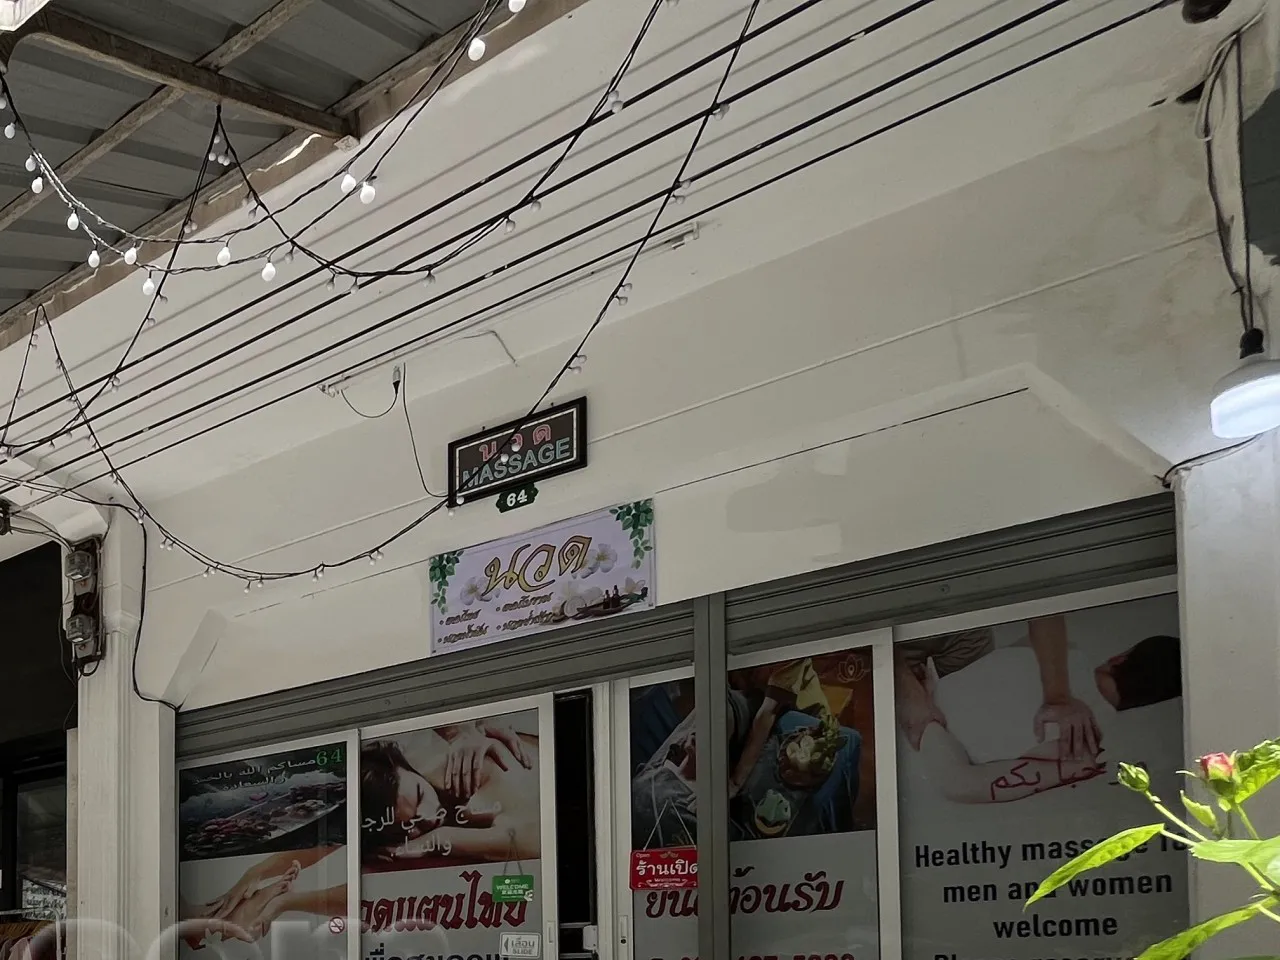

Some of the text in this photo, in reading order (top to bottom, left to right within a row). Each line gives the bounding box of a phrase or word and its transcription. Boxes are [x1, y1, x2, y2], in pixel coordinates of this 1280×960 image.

[462, 437, 570, 490] MASSAGE
[506, 489, 528, 507] 64
[481, 535, 593, 597] นวด
[316, 748, 343, 766] 64
[915, 840, 1012, 870] Healthy
[1022, 834, 1149, 863] mass
[943, 873, 1172, 903] men an women
[993, 914, 1119, 938] welcome
